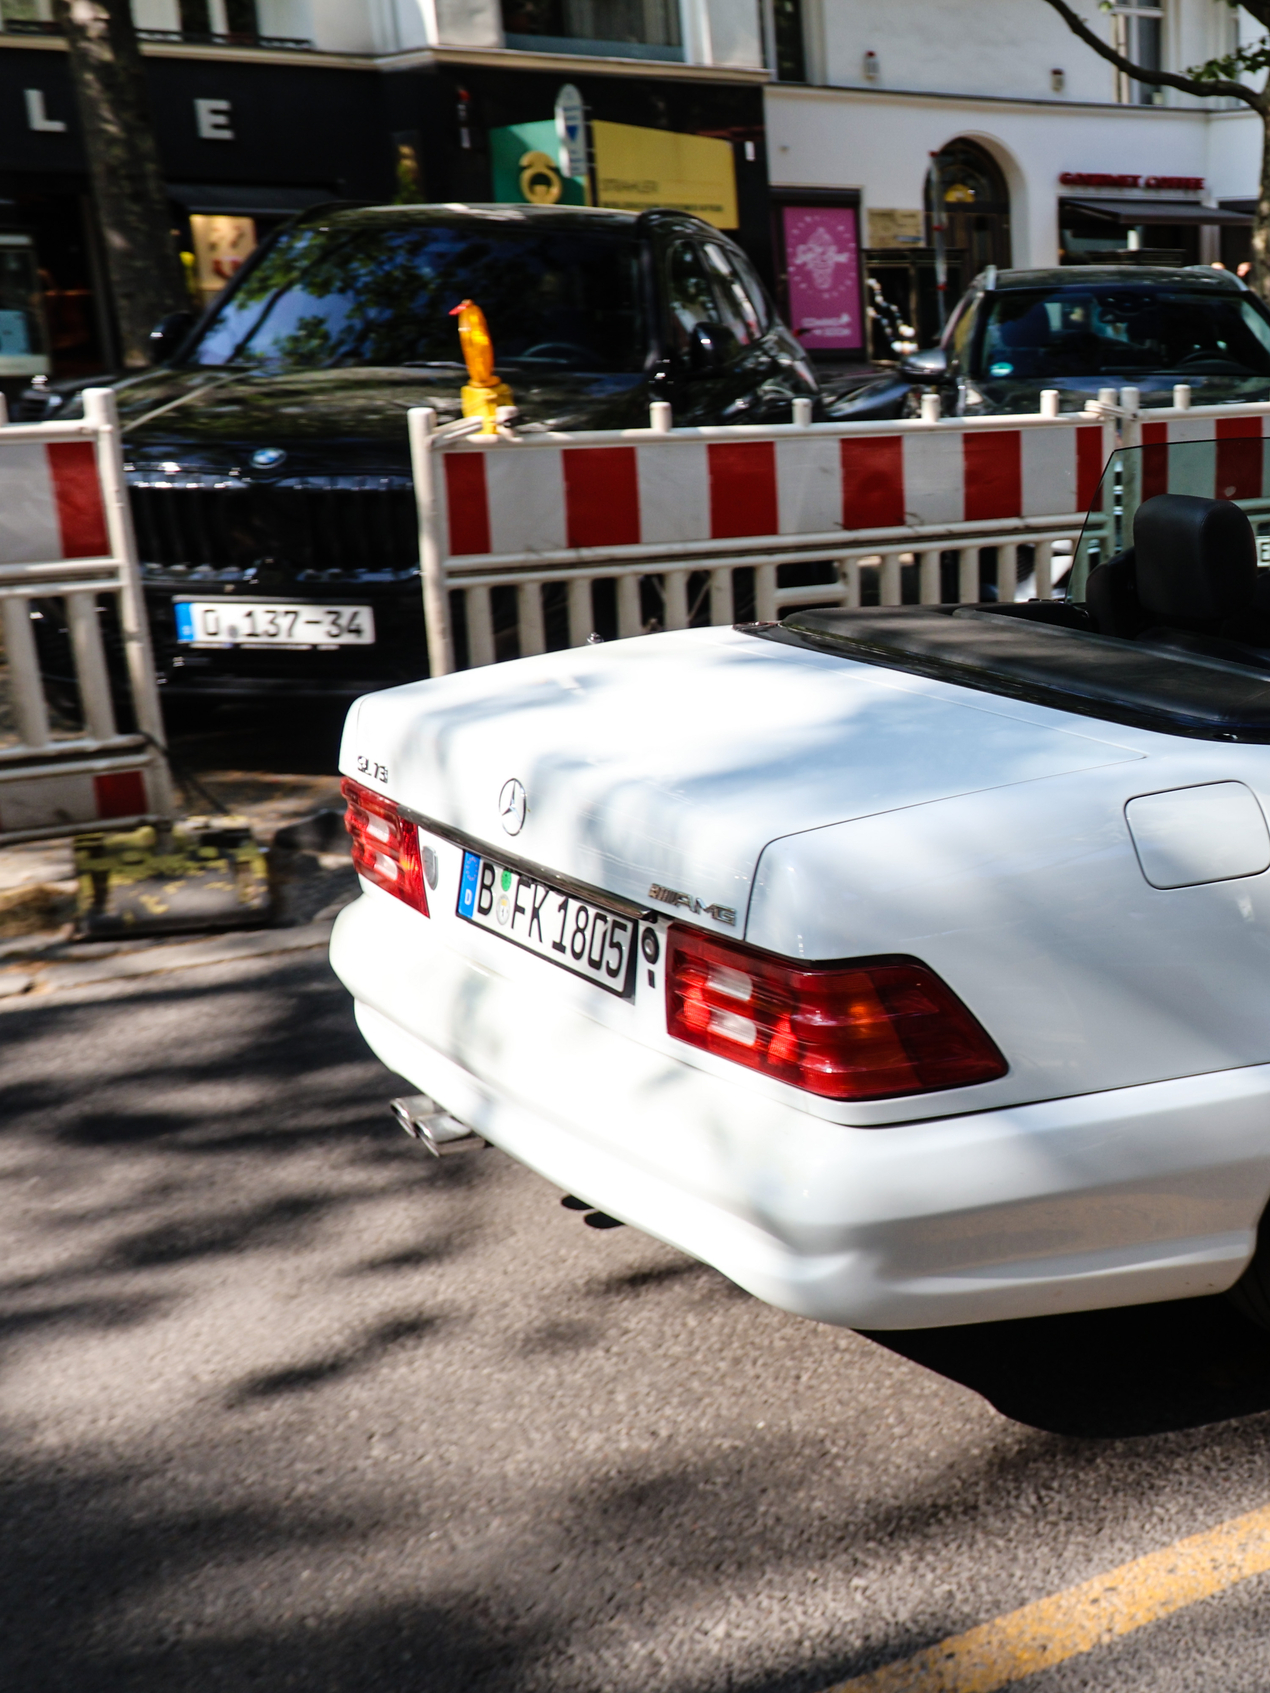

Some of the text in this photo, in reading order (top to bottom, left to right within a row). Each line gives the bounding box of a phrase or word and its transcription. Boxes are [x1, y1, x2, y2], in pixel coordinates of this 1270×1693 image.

[477, 862, 628, 978] B FK 1805
[672, 889, 737, 927] AMG
